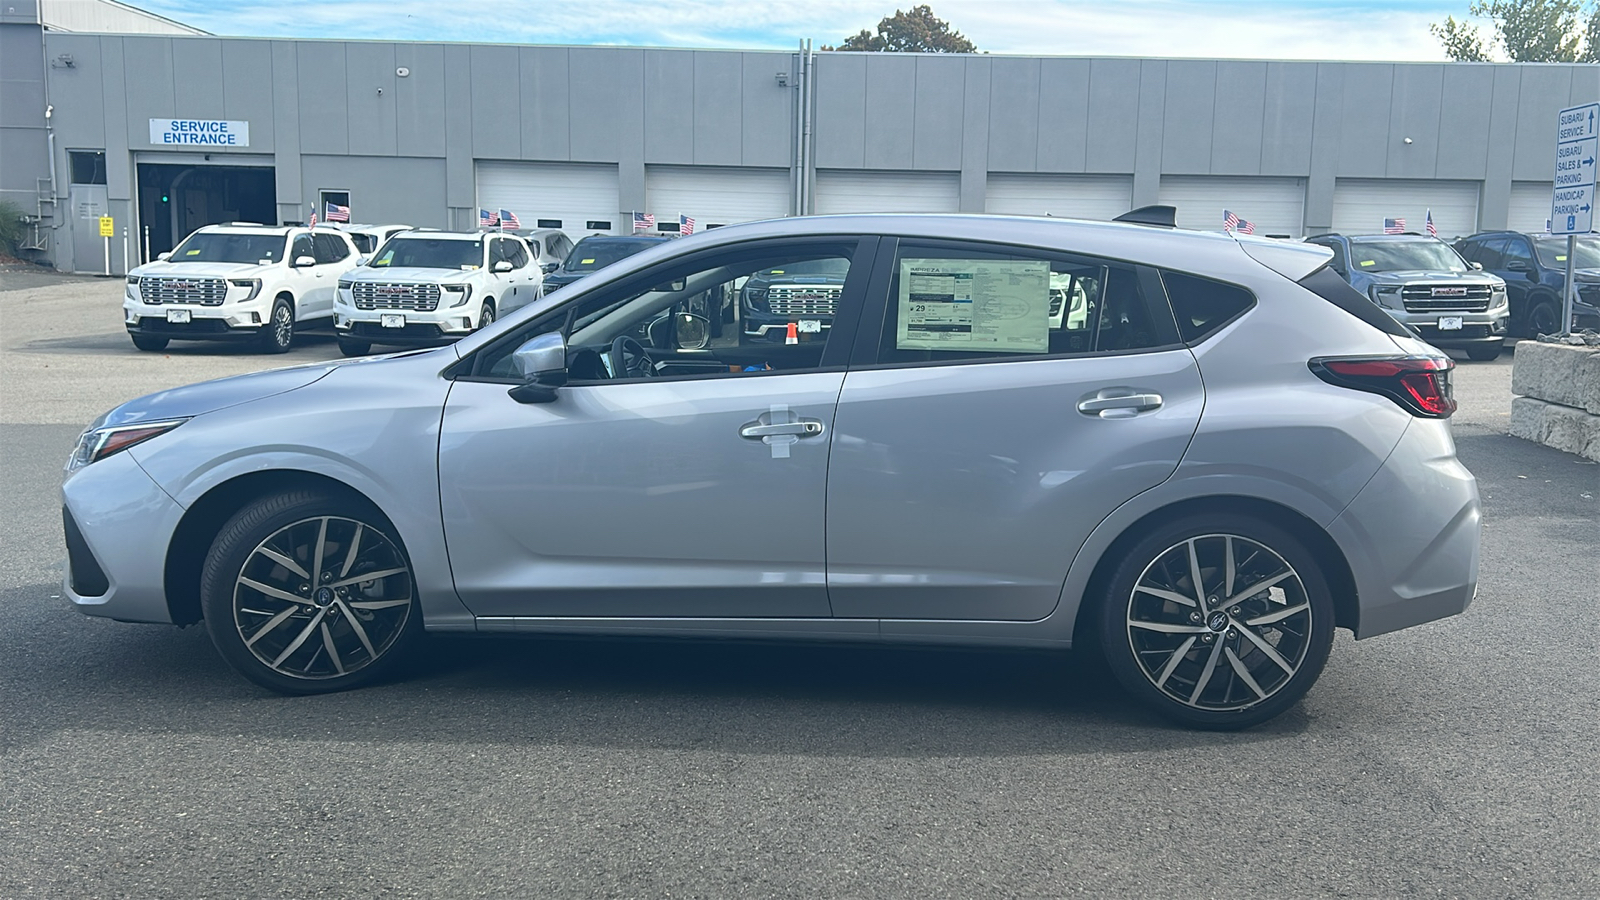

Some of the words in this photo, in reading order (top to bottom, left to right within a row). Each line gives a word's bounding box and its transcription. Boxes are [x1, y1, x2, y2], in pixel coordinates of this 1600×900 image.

[1561, 112, 1584, 125] SUBARU
[171, 121, 228, 132] SERVICE
[1560, 125, 1584, 139] SERVICE
[163, 132, 236, 144] ENTRANCE
[1559, 146, 1582, 158] SUBARU
[1558, 160, 1576, 171] SALES
[1557, 173, 1582, 185] PARKING
[1555, 190, 1585, 202] HANDICAP
[1555, 204, 1579, 214] PARKING
